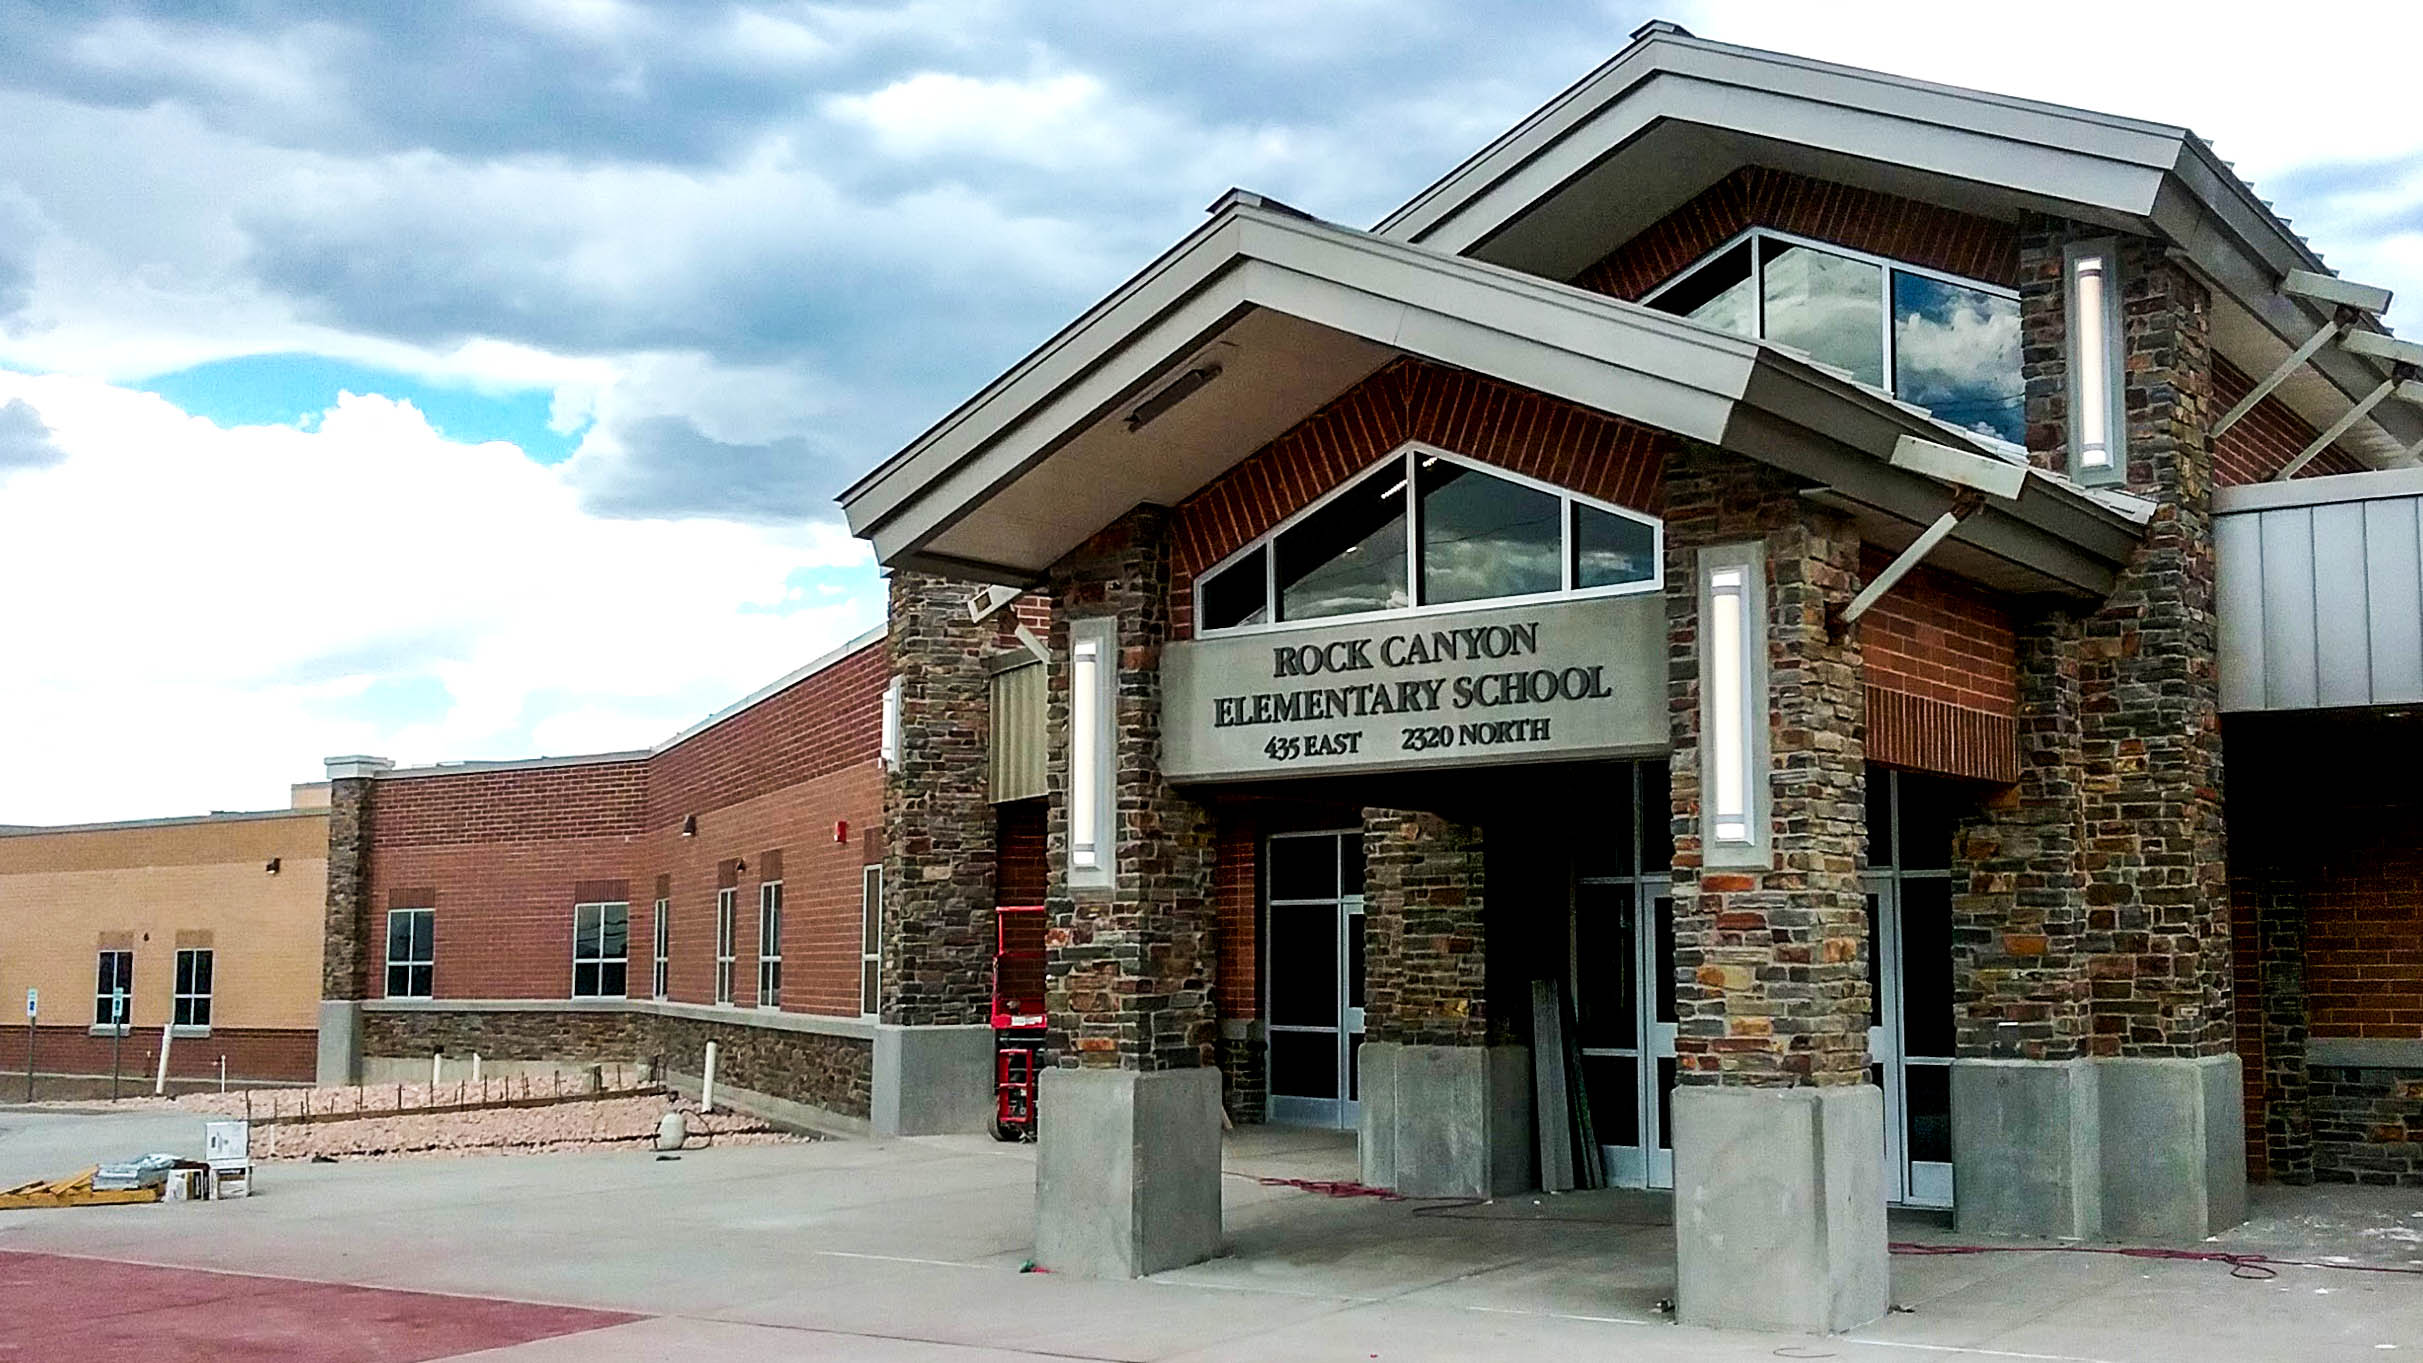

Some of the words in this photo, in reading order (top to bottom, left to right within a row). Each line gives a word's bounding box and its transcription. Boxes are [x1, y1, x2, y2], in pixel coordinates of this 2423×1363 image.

[1273, 638, 1374, 678] ROCK
[1380, 622, 1540, 668] CANYON
[1213, 678, 1447, 727] ELEMENTARY
[1452, 665, 1612, 709] SCHOOL
[1263, 735, 1300, 760] 435
[1304, 731, 1362, 757] EAST
[1401, 723, 1455, 751] 2320
[1459, 718, 1551, 746] NORTH
